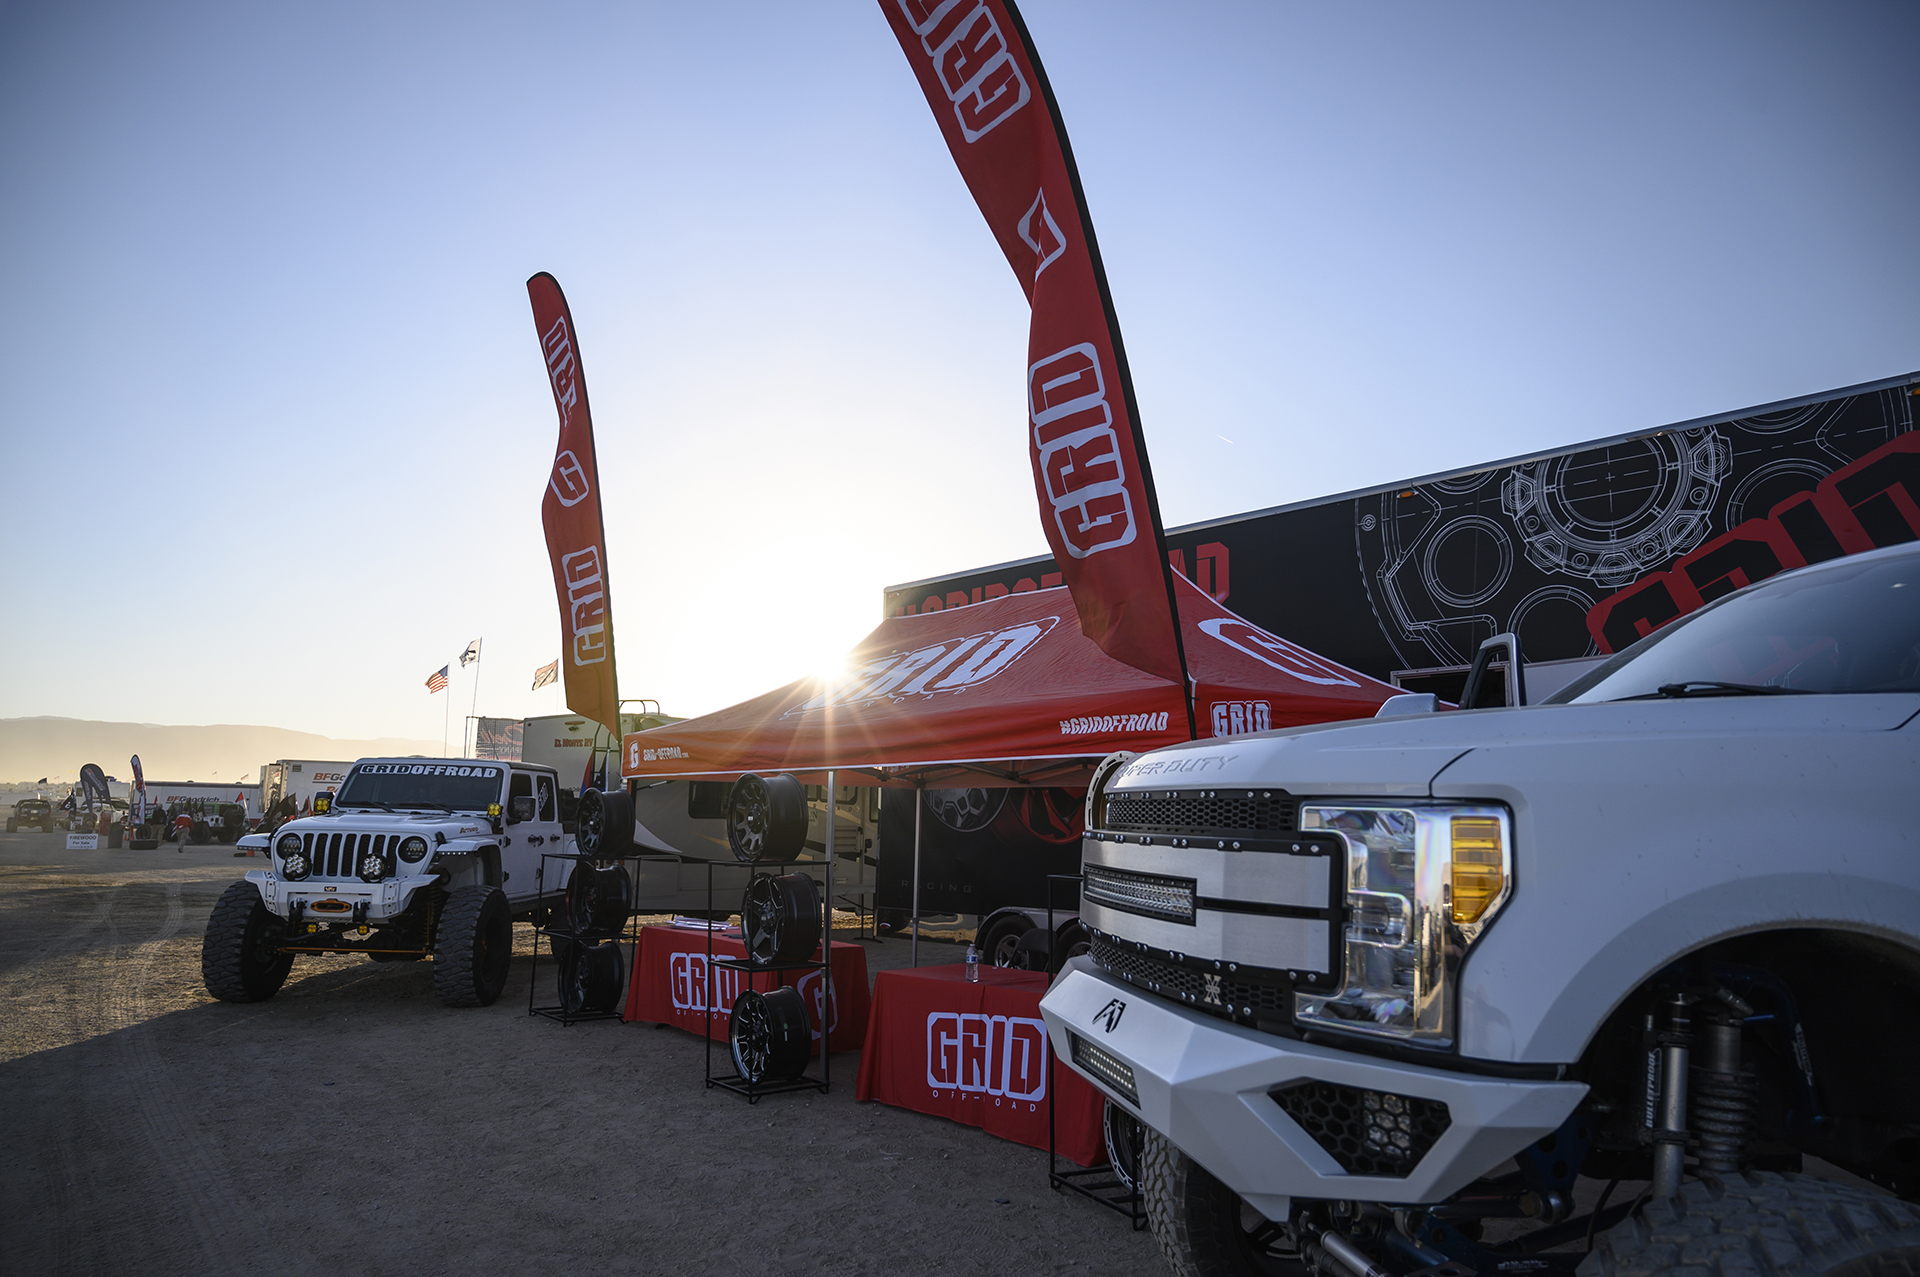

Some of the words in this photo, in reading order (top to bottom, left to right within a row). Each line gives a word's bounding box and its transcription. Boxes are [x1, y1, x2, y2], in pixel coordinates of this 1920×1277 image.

[1028, 342, 1137, 559] GRID
[550, 450, 590, 508] G
[562, 545, 607, 667] GRID
[1059, 711, 1169, 735] #GRIDOFFROAD
[1210, 699, 1272, 738] GRID
[1163, 754, 1240, 774] DUTY
[167, 795, 220, 803] BFGoodrich
[927, 1011, 1048, 1102] GRID
[932, 1089, 1036, 1112] OFF-OAD
[1645, 1050, 1657, 1128] BULLETPROOF
